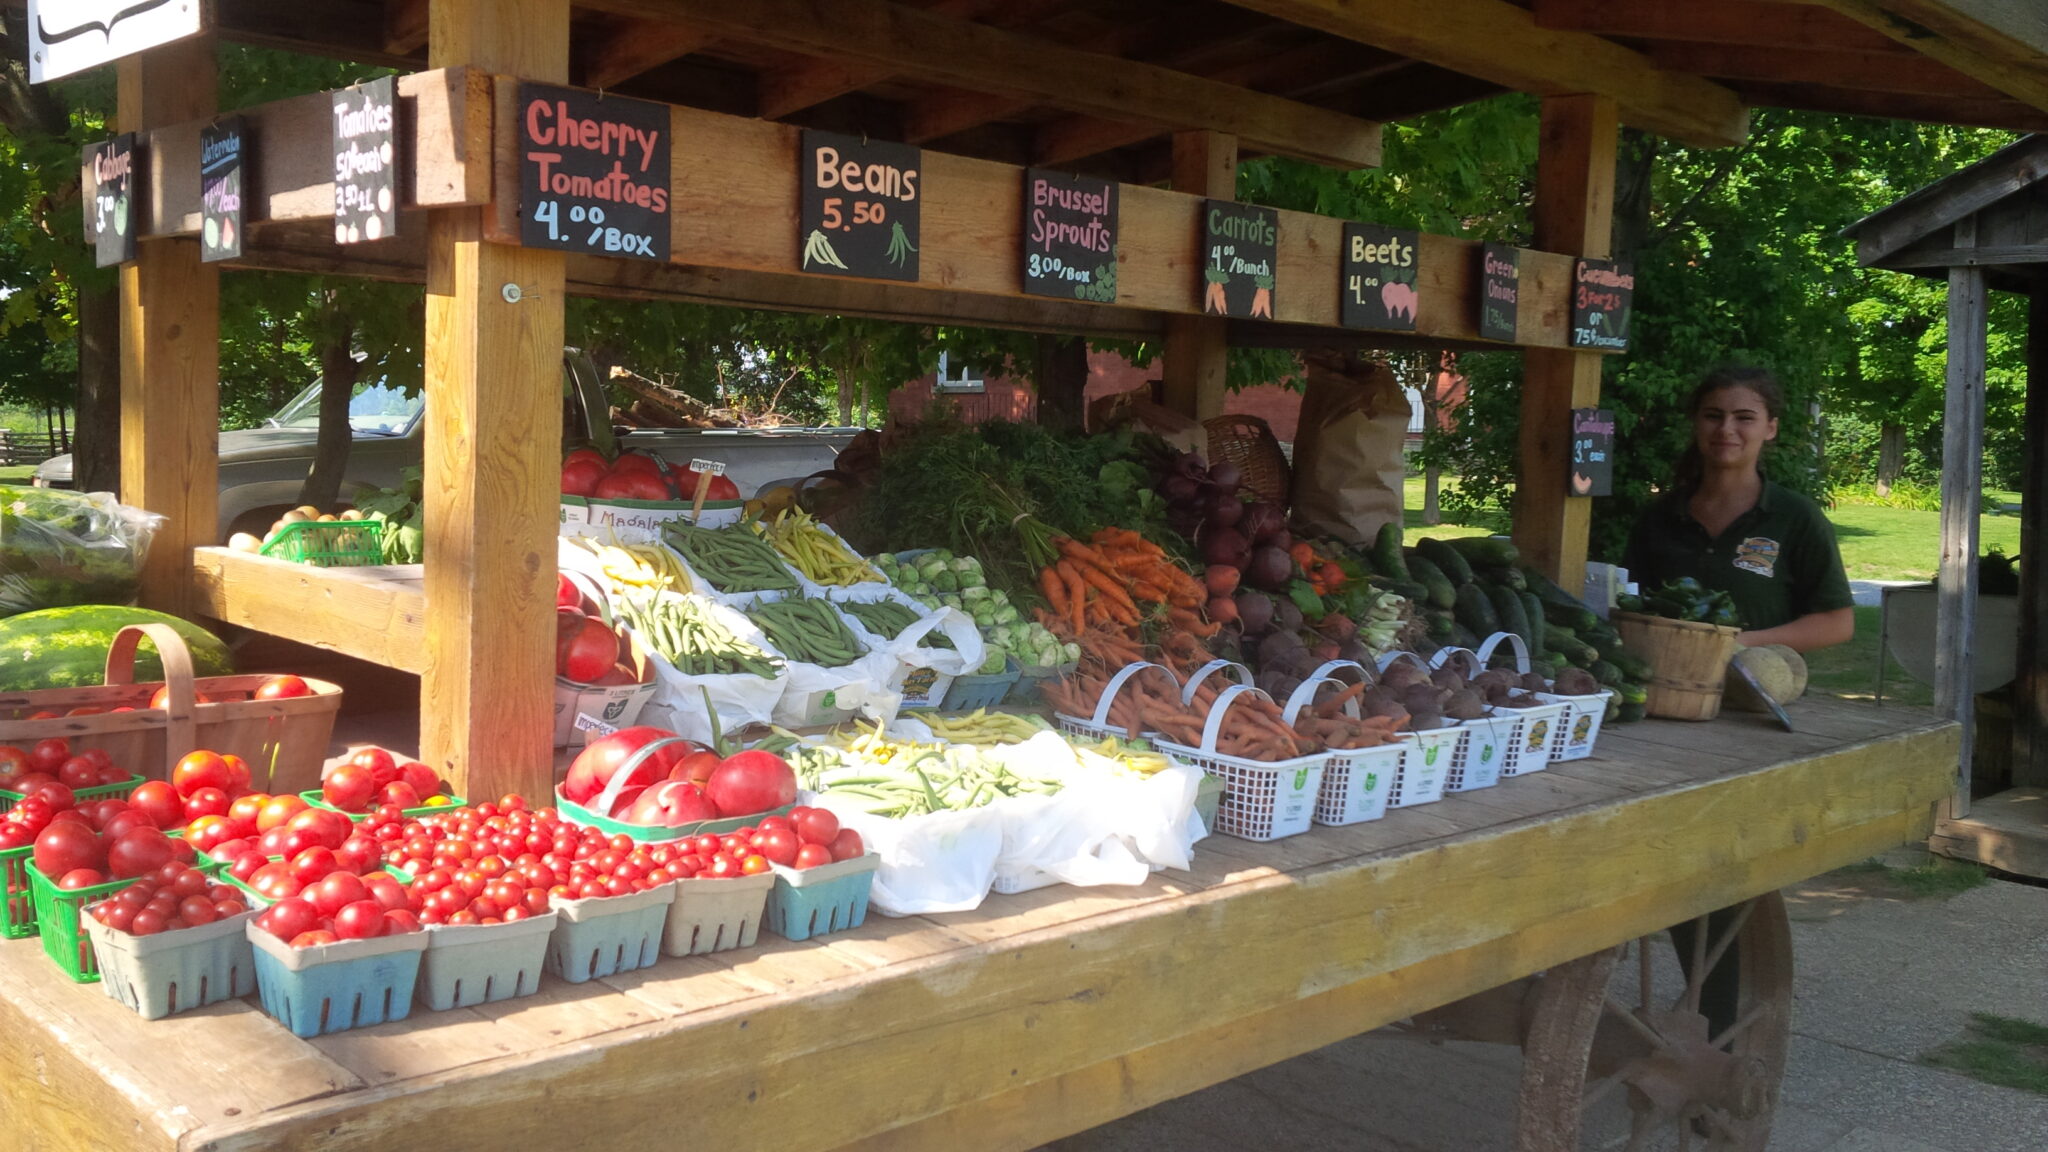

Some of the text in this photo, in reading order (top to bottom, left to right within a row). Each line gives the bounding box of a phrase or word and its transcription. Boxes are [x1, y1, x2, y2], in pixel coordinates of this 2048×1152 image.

[334, 95, 393, 138] Tomatoes
[526, 99, 658, 172] Cherry
[95, 143, 131, 190] Cabbage
[527, 152, 668, 213] Tomatoes
[816, 146, 917, 201] Beans
[822, 198, 886, 232] 5.50
[1034, 179, 1109, 216] Brussel
[1031, 208, 1111, 252] Sprouts
[1209, 209, 1275, 247] Carrots
[1351, 235, 1413, 267] Beets
[1485, 251, 1514, 279] Green
[1349, 275, 1379, 305] 4.00
[1488, 279, 1516, 304] Onions
